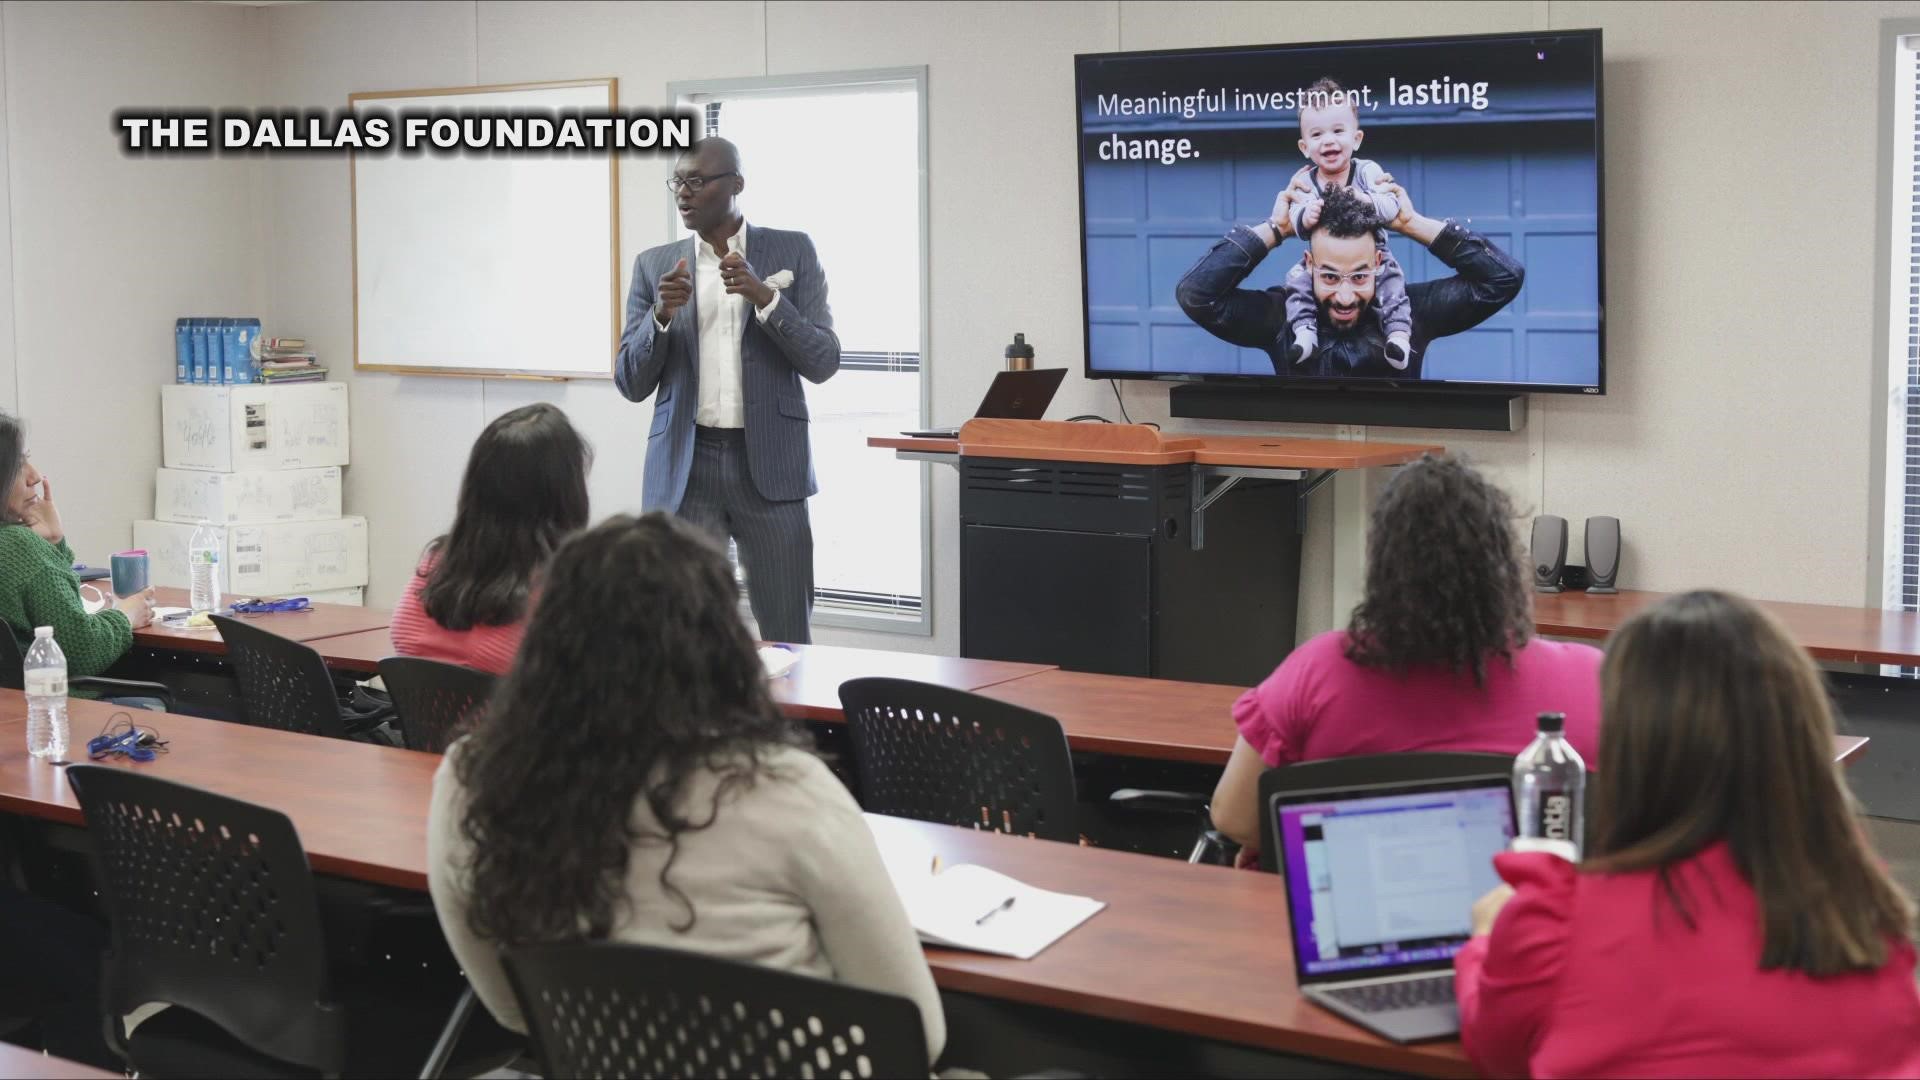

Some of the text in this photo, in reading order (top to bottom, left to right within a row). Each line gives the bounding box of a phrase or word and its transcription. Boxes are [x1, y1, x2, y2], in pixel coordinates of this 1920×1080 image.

[1098, 76, 1489, 119] Meaningful investment, lasting
[1099, 133, 1200, 165] change.
